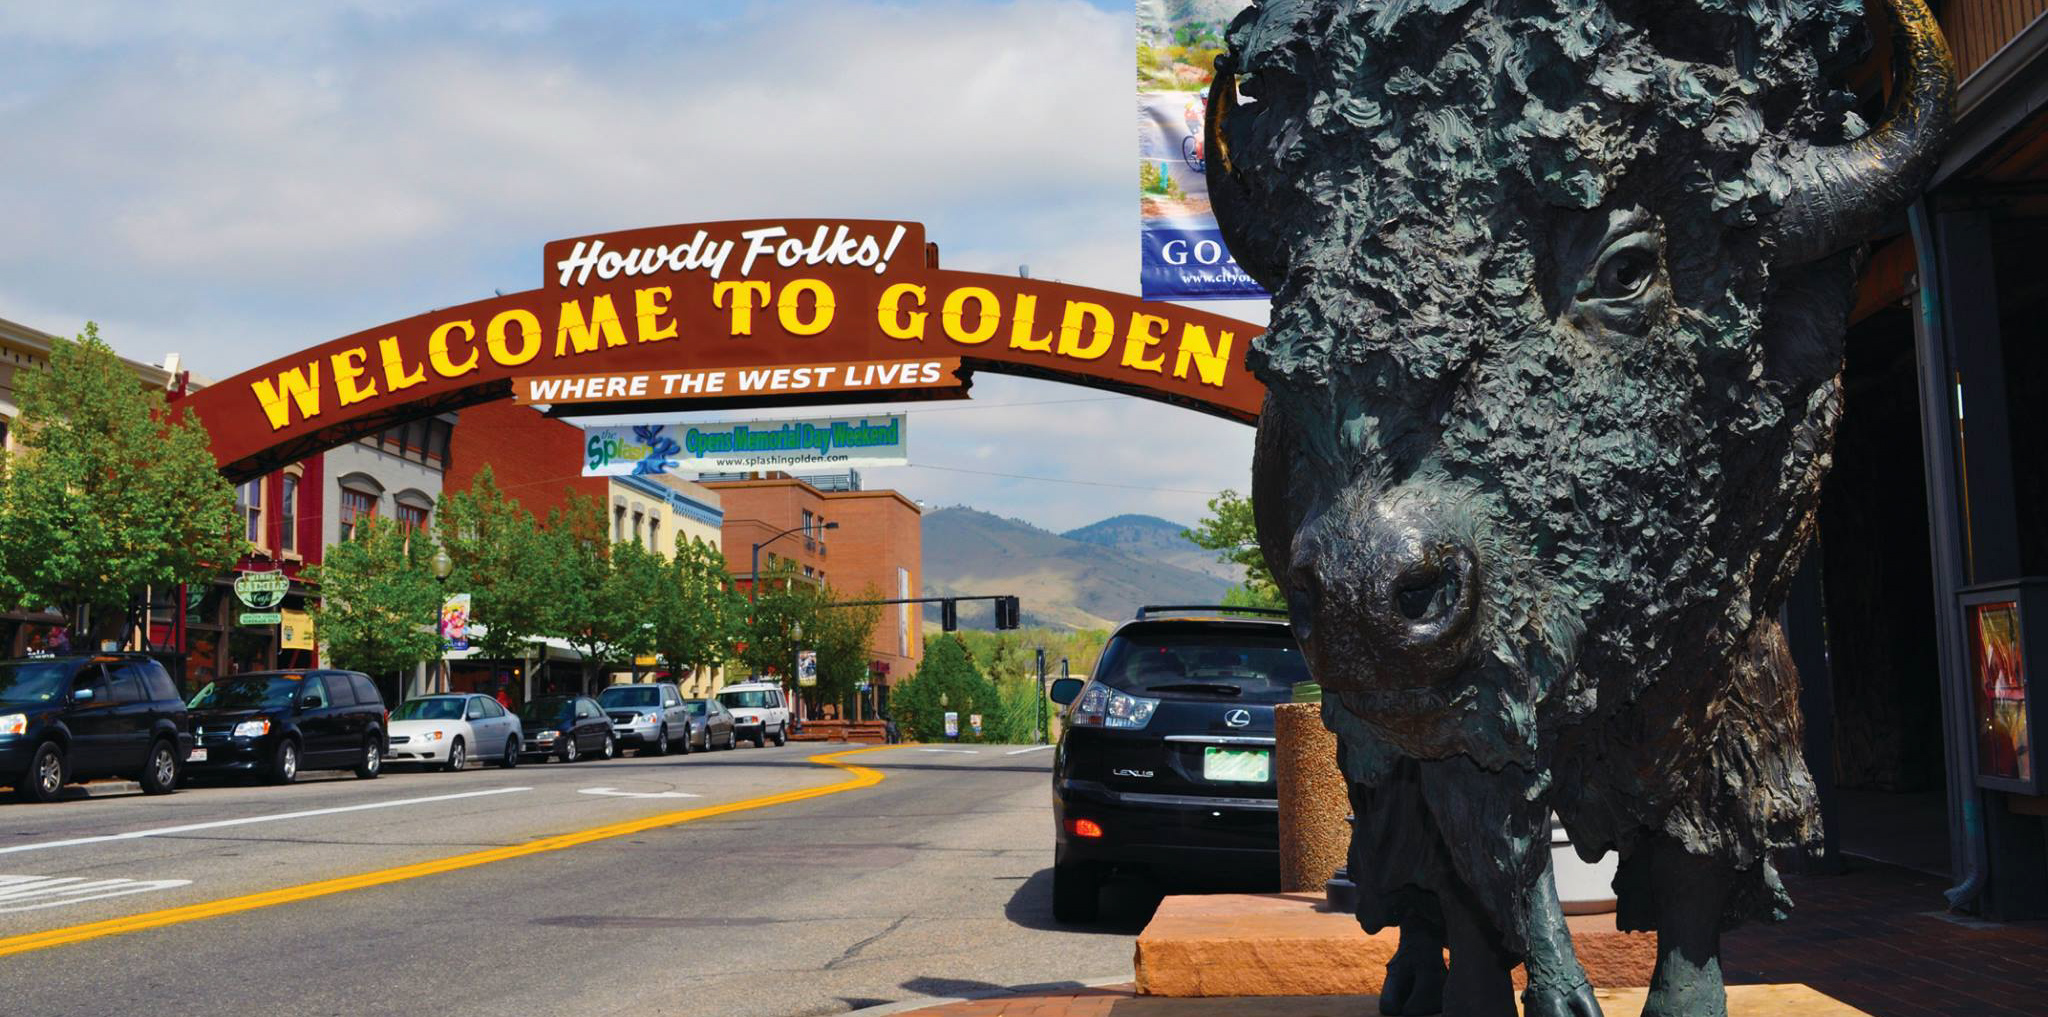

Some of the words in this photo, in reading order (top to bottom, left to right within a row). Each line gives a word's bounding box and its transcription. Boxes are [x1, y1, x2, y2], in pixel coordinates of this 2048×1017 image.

[557, 230, 734, 287] Howdy
[741, 225, 906, 276] Folks!
[1162, 240, 1237, 265] GO
[250, 286, 678, 431] WELCOME
[713, 279, 836, 335] TO
[878, 283, 1235, 387] GOLDEN
[529, 375, 649, 400] WHERE
[660, 371, 725, 394] THE
[738, 366, 836, 390] WEST
[844, 362, 942, 386] LIVES
[601, 429, 617, 440] the
[686, 427, 733, 458] Opens
[734, 423, 801, 451] Memorial
[802, 422, 831, 456] Day
[831, 417, 898, 447] Weekend
[716, 453, 848, 466] www.splashingolden.com
[1113, 769, 1154, 777] LEXUS
